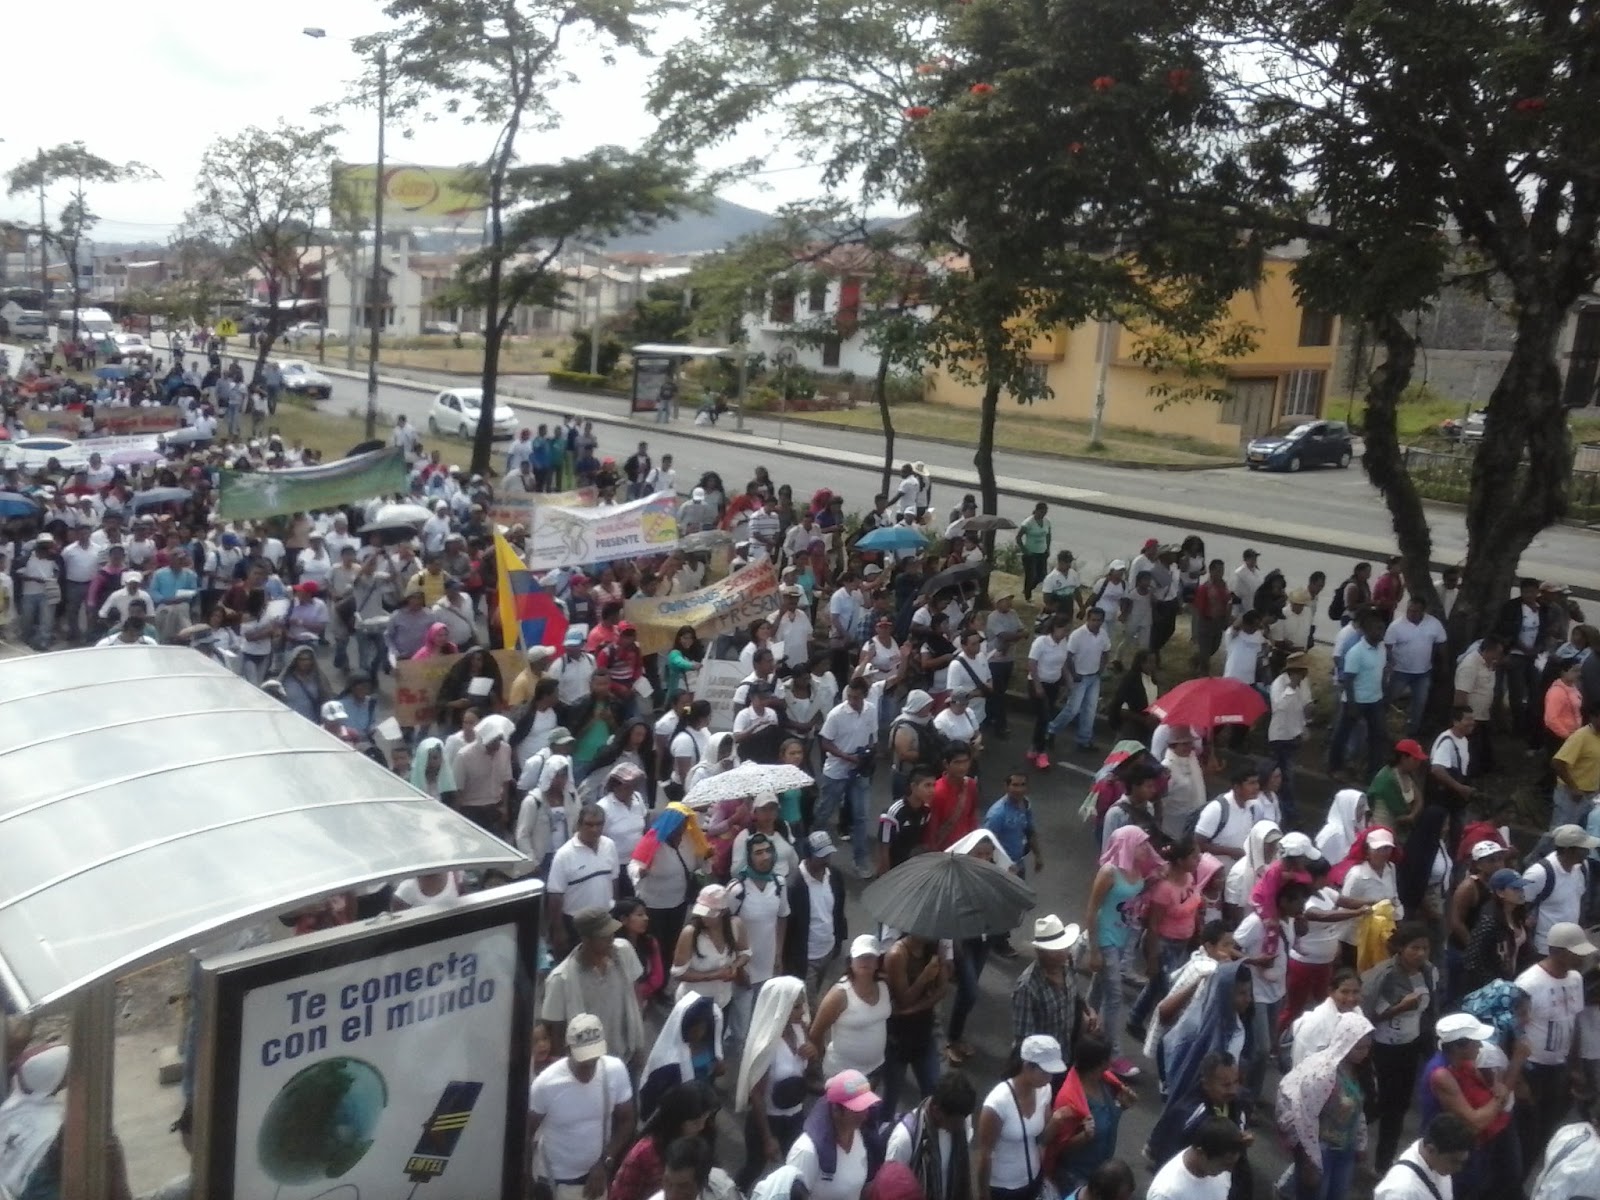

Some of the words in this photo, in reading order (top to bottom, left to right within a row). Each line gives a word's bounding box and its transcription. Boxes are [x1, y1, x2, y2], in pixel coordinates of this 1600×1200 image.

[261, 1025, 327, 1067] con
[341, 1005, 372, 1043] el
[386, 977, 495, 1032] mundo
[287, 989, 326, 1025] Te
[340, 950, 479, 1010] conecta
